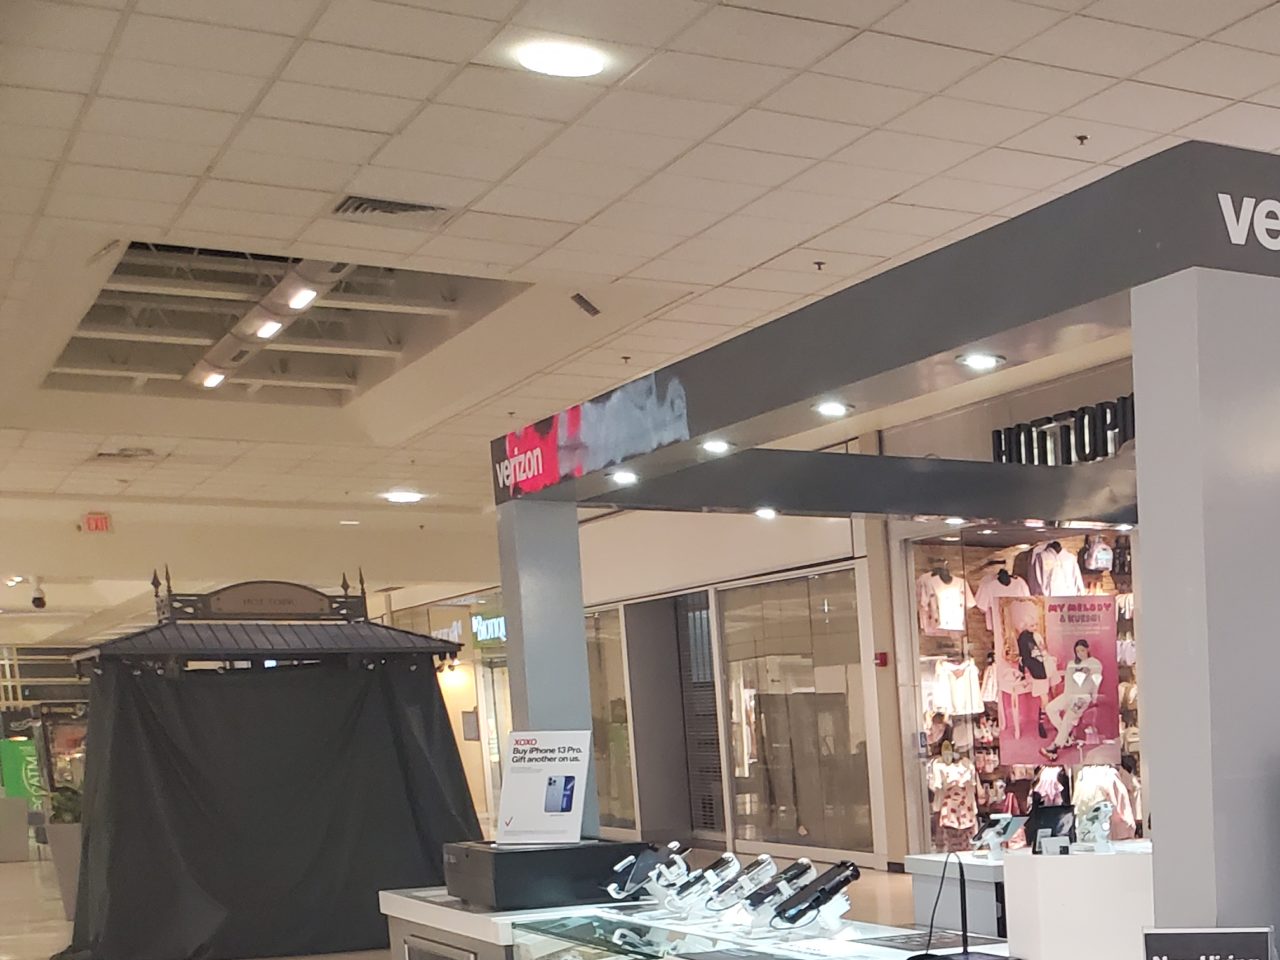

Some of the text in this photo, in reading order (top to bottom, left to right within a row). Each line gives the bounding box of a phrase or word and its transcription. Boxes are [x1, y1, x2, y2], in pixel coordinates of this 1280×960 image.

[495, 446, 543, 488] verizon
[513, 738, 538, 746] XOXO
[512, 747, 528, 755] Buy
[567, 746, 583, 754] Pro.
[512, 756, 526, 764] Gift
